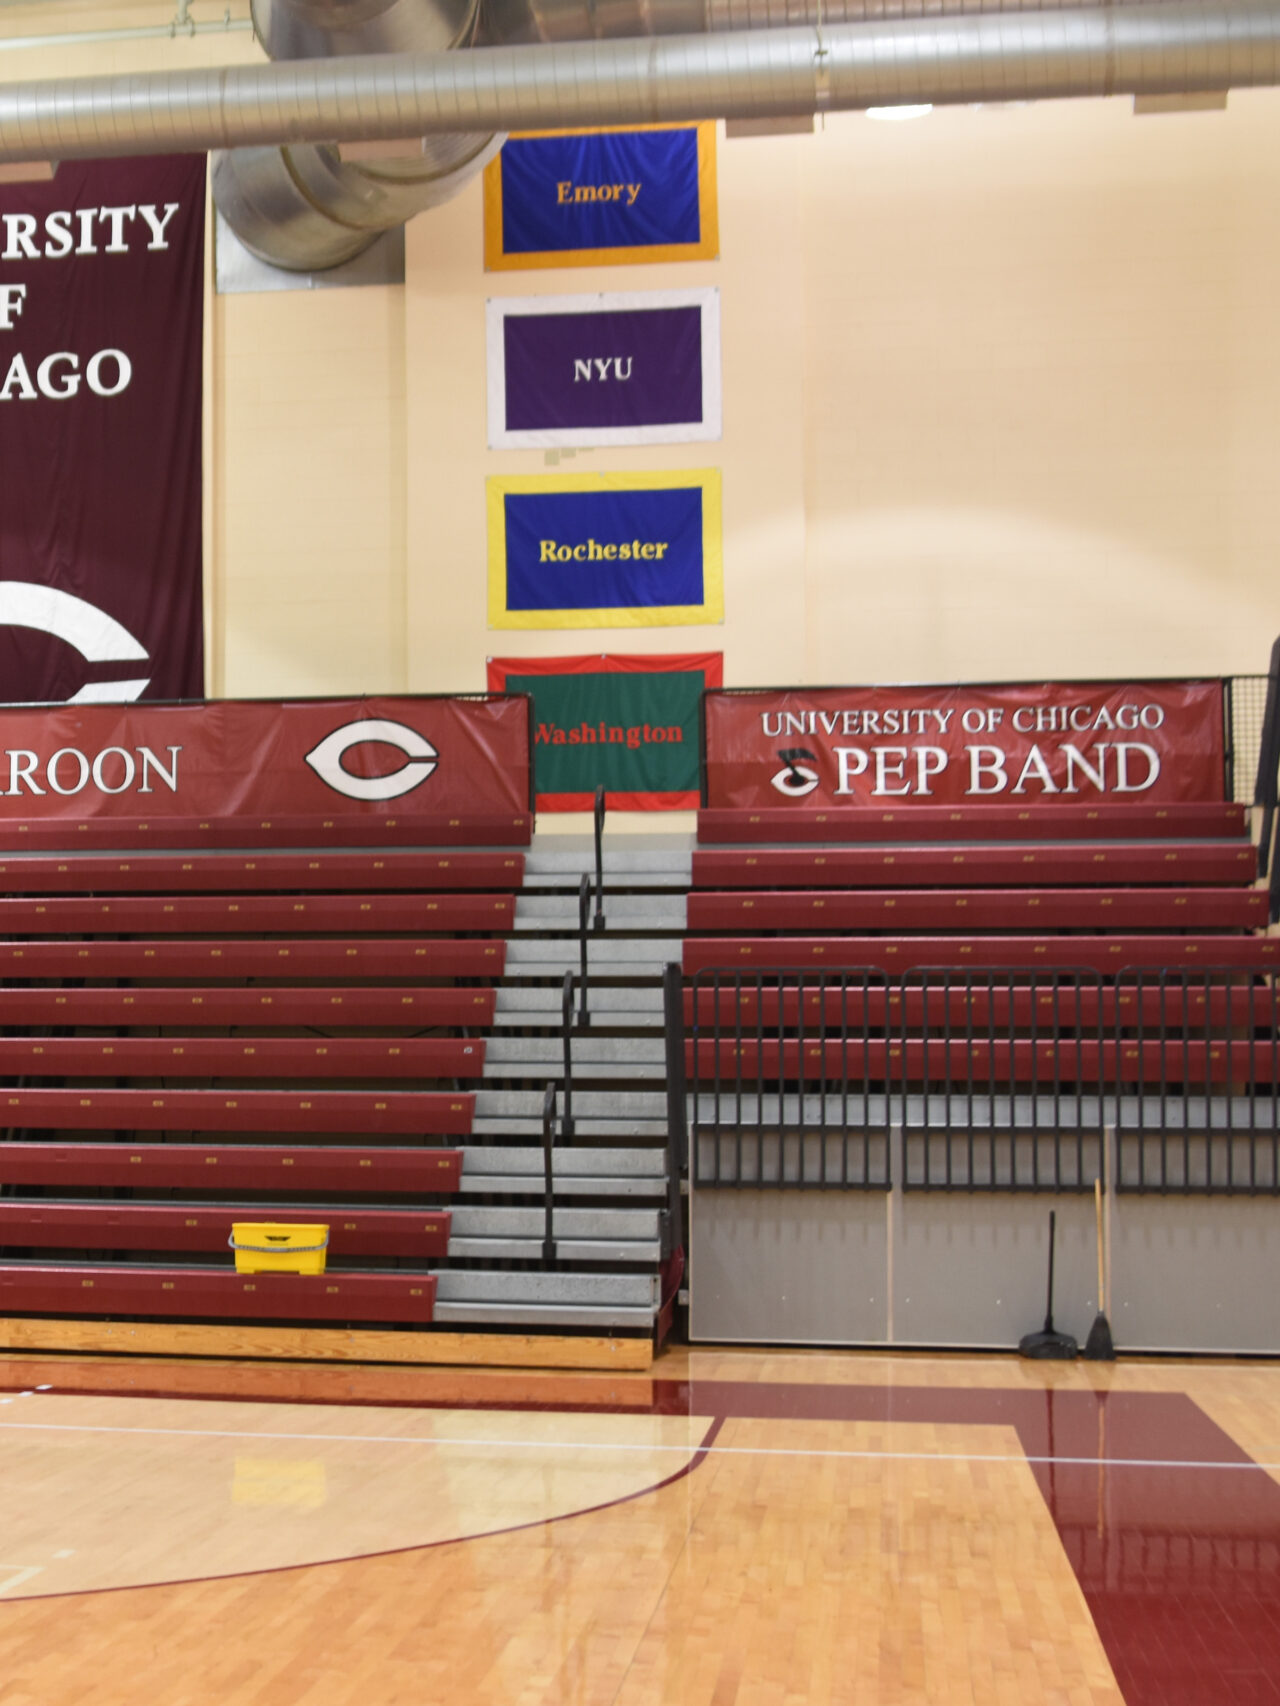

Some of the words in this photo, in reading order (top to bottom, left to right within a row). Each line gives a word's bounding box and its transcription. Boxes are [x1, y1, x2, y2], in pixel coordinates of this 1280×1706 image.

[556, 181, 642, 205] Emory
[573, 356, 633, 382] NYU
[539, 539, 668, 562] Rochester
[761, 708, 955, 737] UNIVERSITY
[961, 708, 1004, 734] OF
[1012, 703, 1165, 733] CHICAGO
[832, 746, 949, 796] PEP
[964, 742, 1161, 795] BAND
